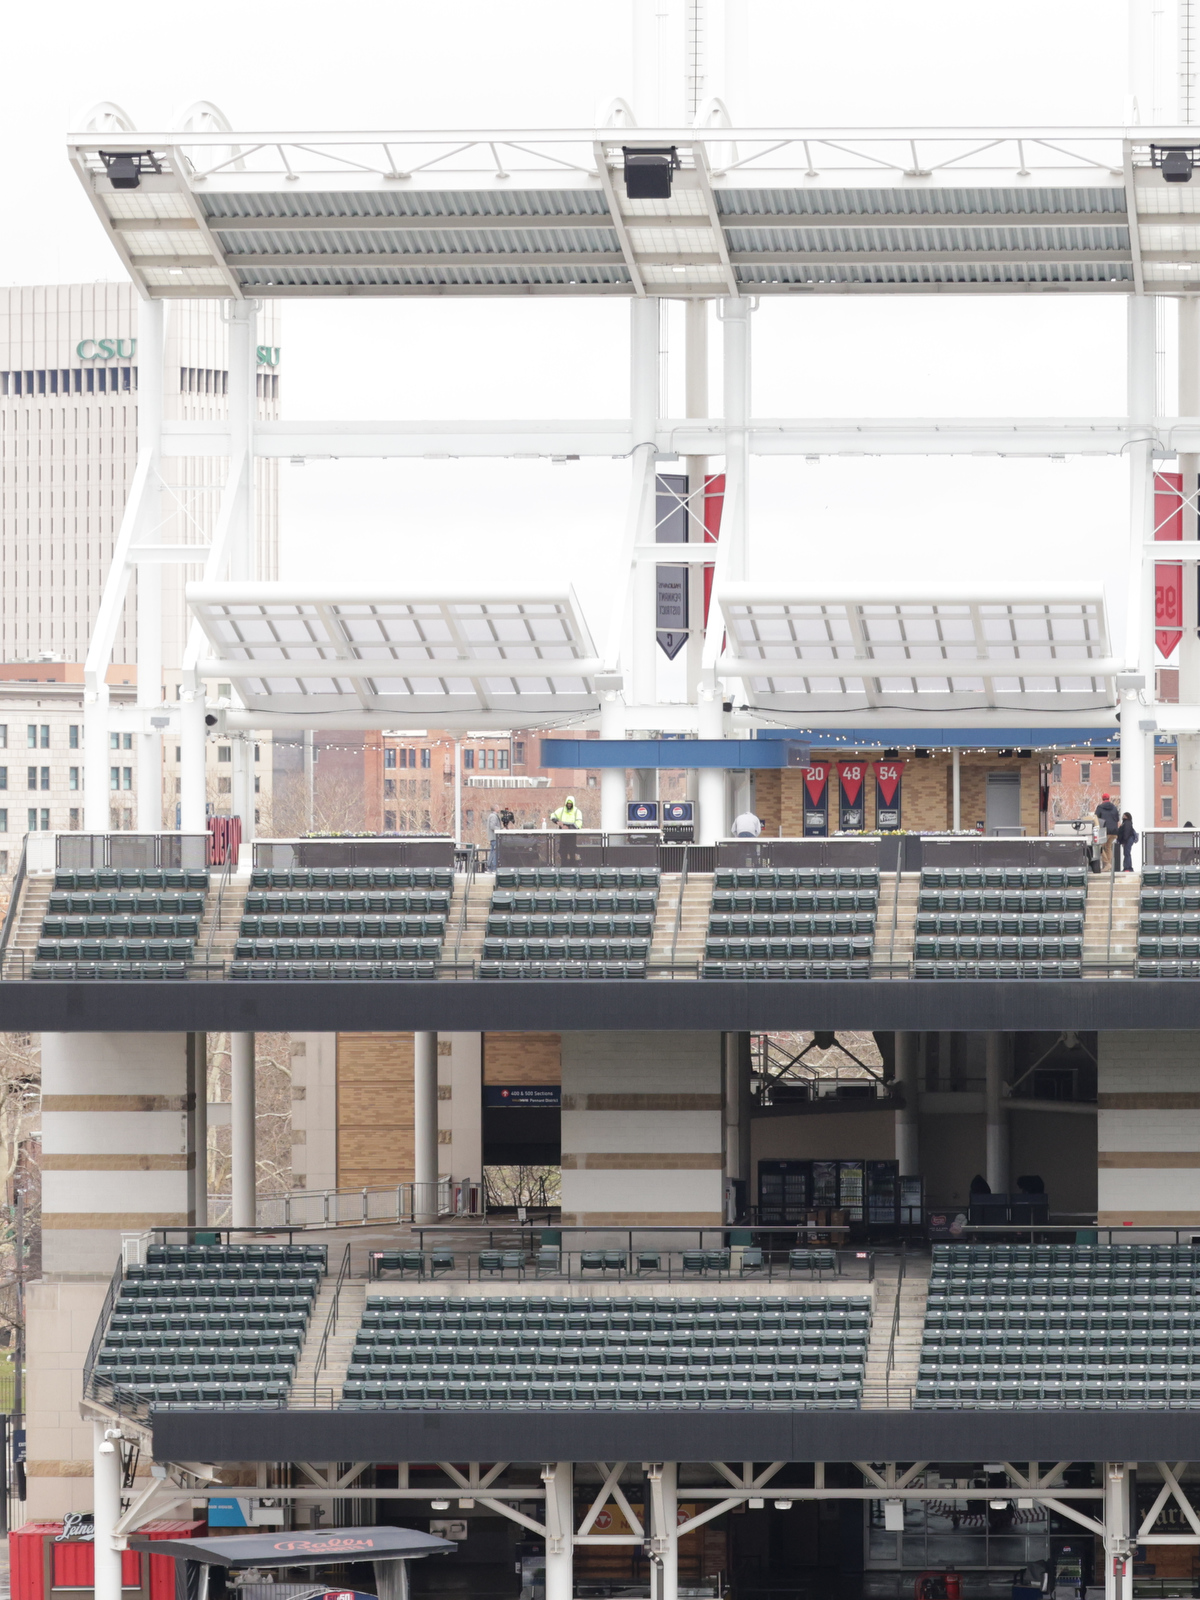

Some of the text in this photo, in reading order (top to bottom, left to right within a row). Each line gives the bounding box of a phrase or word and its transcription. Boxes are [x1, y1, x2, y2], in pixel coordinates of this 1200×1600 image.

[76, 338, 137, 360] CSU
[256, 345, 281, 367] SU
[806, 766, 824, 781] 20
[843, 766, 861, 781] 48
[879, 766, 898, 781] 54
[54, 1513, 95, 1541] Leine
[273, 1538, 374, 1551] Bally
